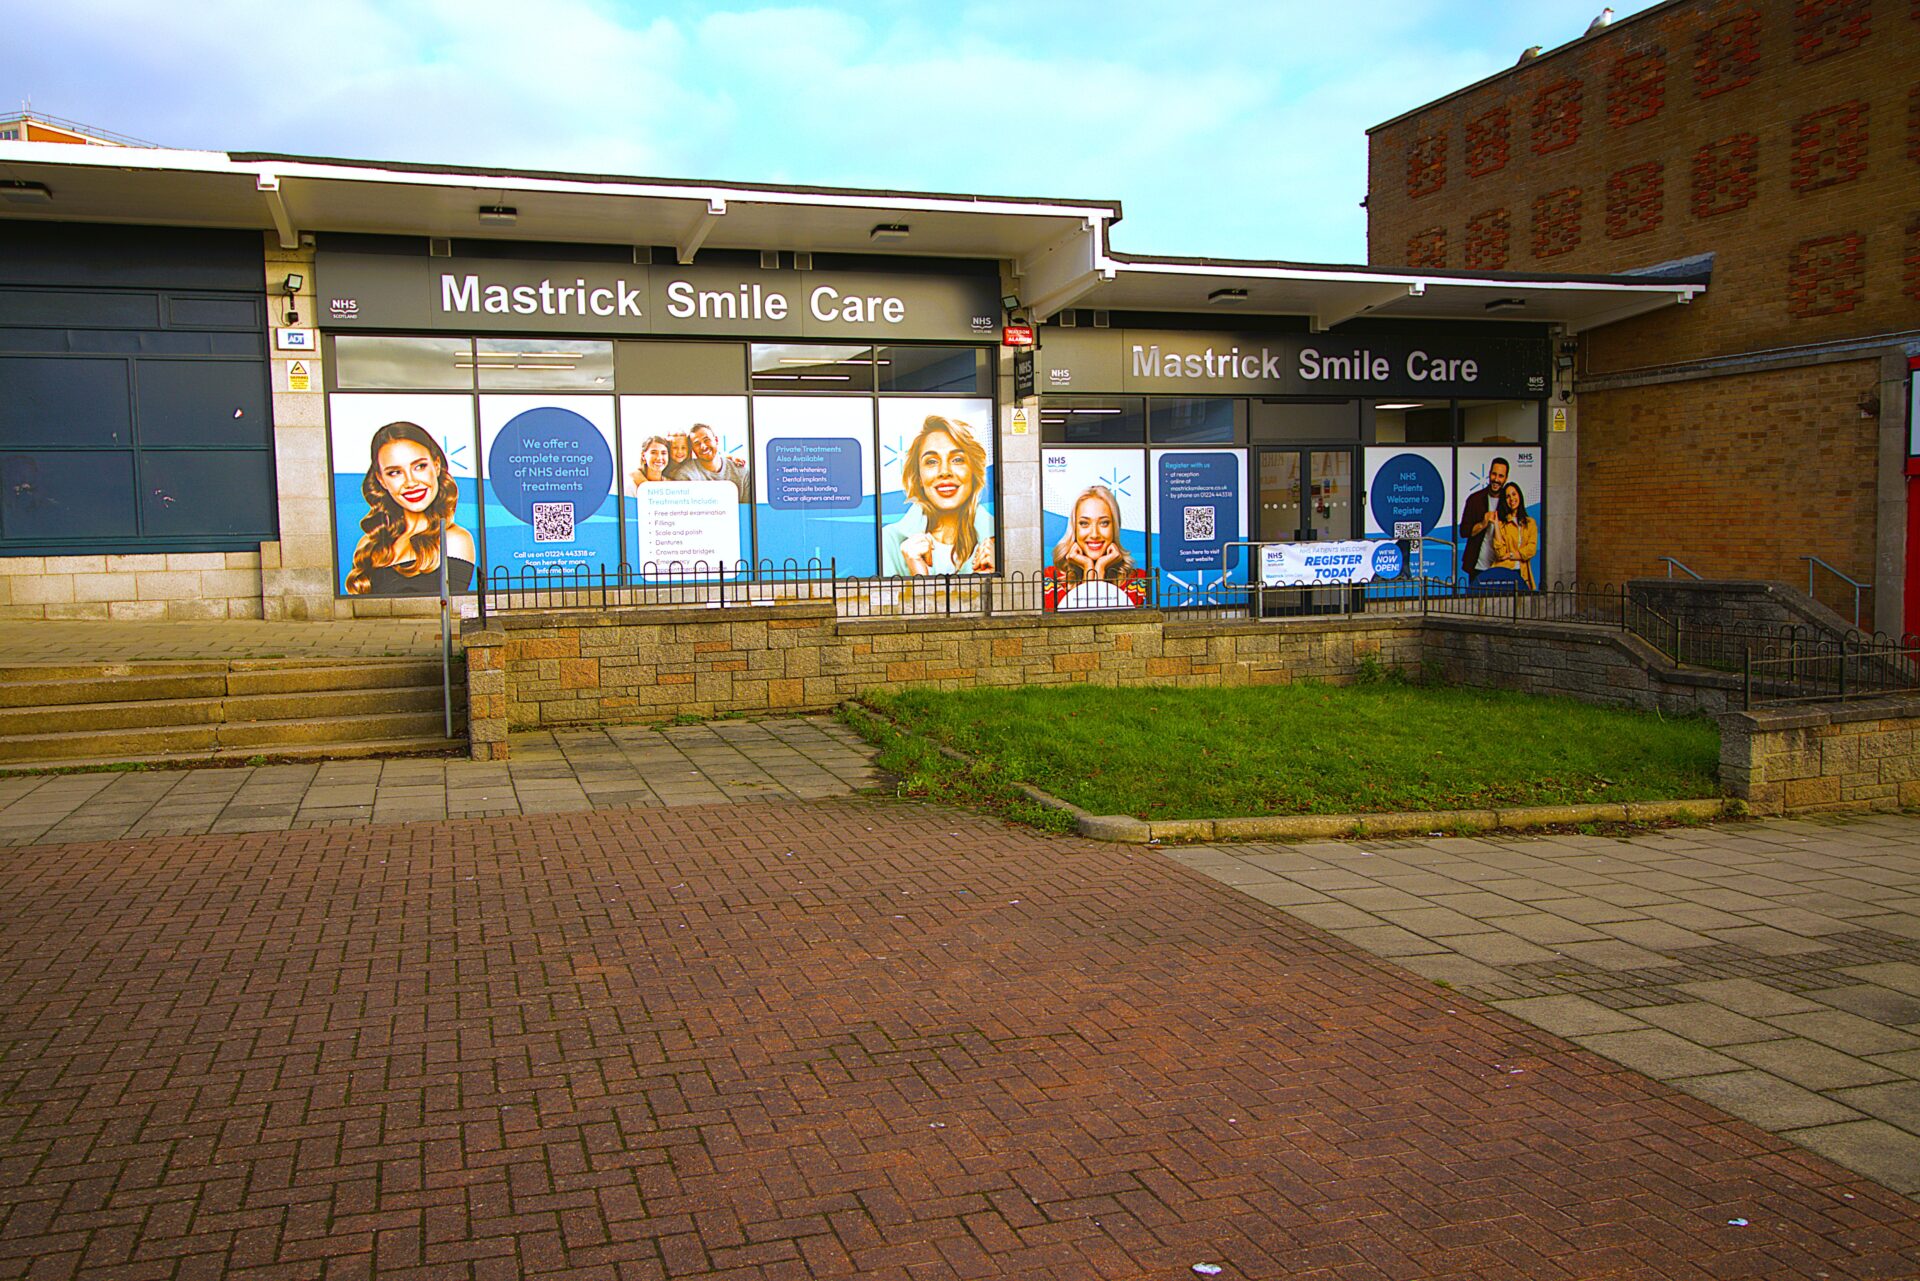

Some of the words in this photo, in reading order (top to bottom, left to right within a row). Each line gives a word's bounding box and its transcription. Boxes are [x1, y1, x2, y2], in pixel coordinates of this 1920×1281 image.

[441, 274, 642, 316] Mastrick
[667, 281, 788, 320] Smile
[810, 286, 905, 323] Care
[332, 299, 357, 309] NHS
[972, 317, 992, 325] NHS
[288, 334, 304, 344] ADT
[1019, 361, 1032, 374] NHS
[1132, 345, 1280, 379] Mastrick
[1299, 349, 1390, 381] Smile
[1406, 351, 1478, 382] Care
[1051, 369, 1070, 377] NHS
[523, 438, 541, 449] We
[543, 438, 570, 449] offer
[572, 441, 579, 449] a
[509, 453, 560, 465] complete
[562, 456, 594, 465] range
[514, 467, 527, 477] of
[528, 468, 553, 477] NHS
[555, 467, 589, 477] dental
[522, 482, 583, 491] treatments
[1393, 484, 1423, 492] Patients
[1393, 507, 1423, 516] Register
[693, 548, 715, 556] bridges
[1304, 554, 1363, 566] REGISTER
[1376, 556, 1398, 564] NOW
[1375, 564, 1400, 572] OPEN!
[1314, 568, 1356, 579] TODAY
